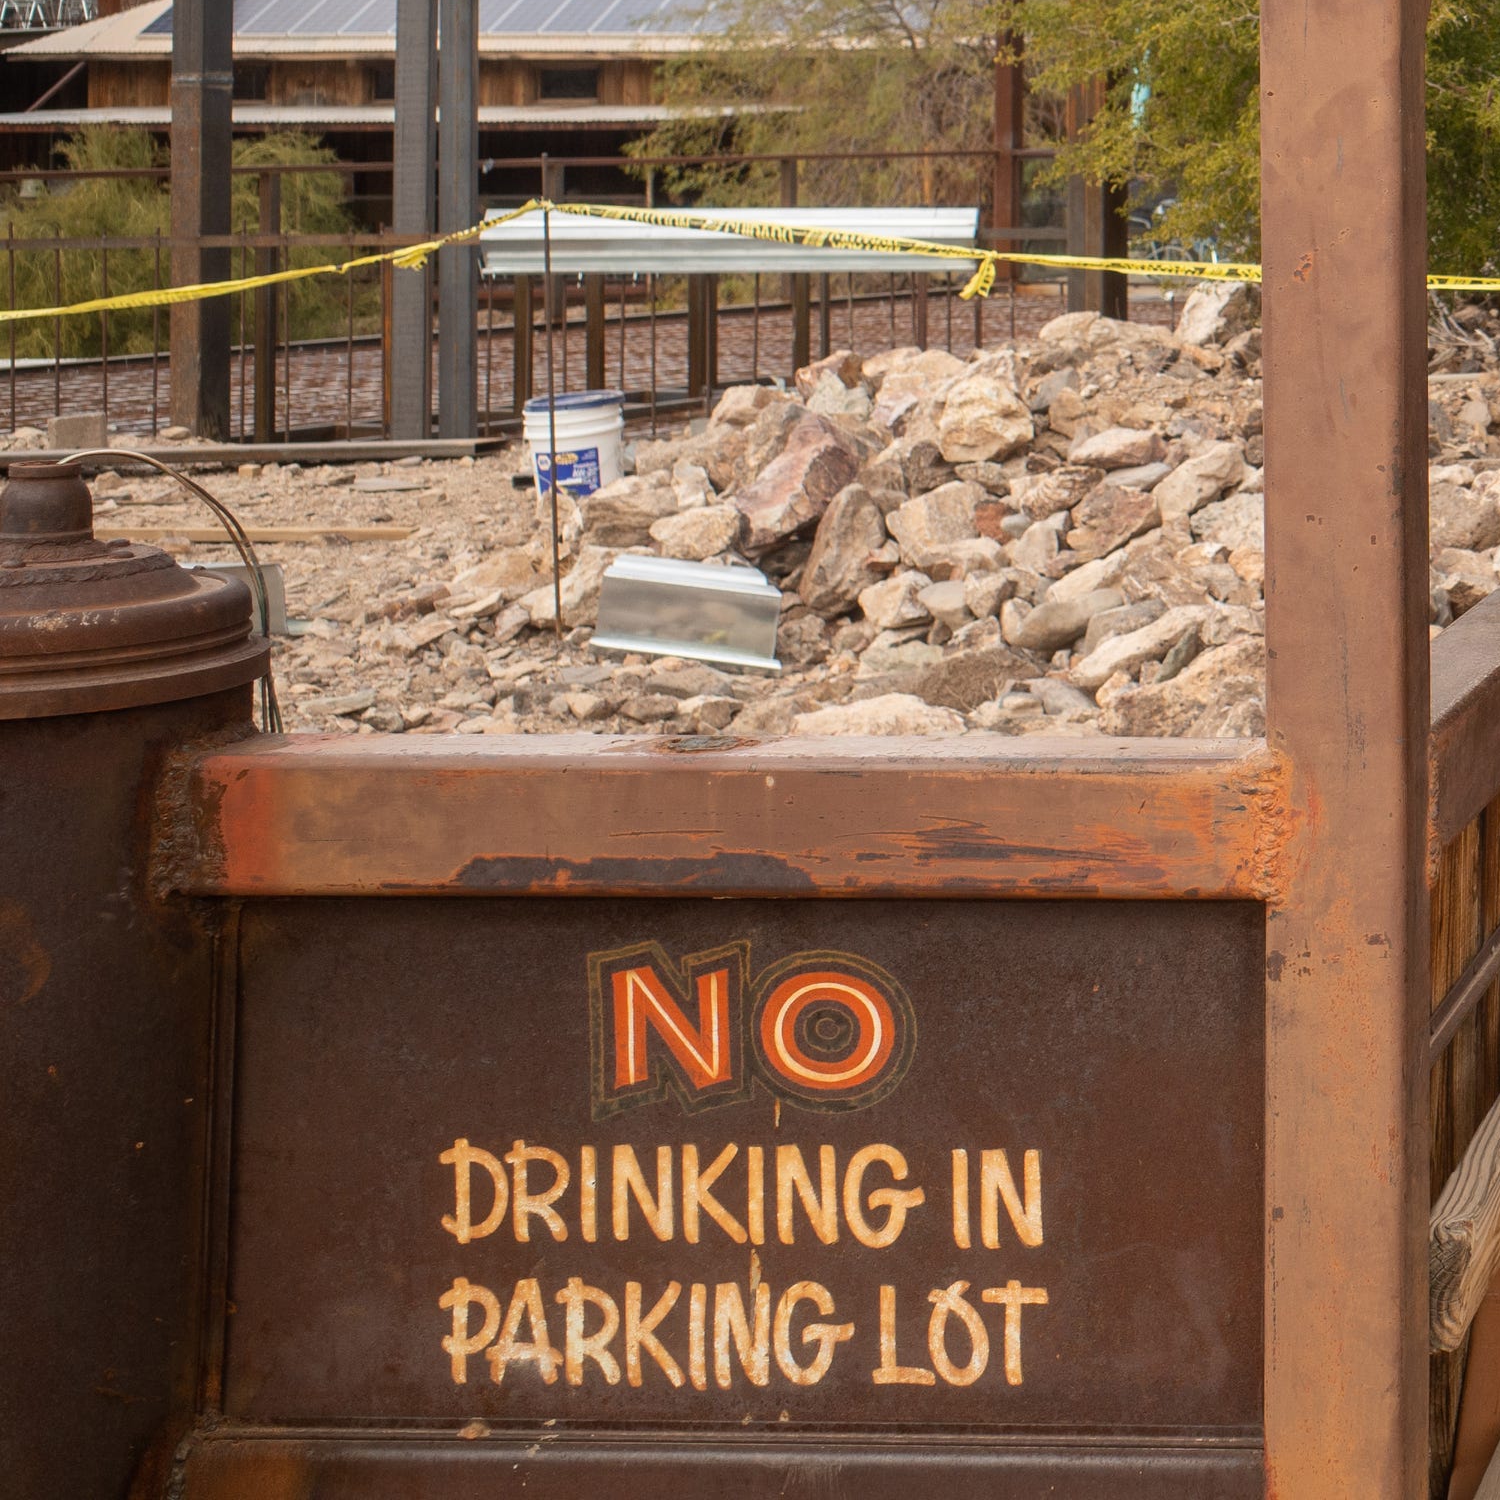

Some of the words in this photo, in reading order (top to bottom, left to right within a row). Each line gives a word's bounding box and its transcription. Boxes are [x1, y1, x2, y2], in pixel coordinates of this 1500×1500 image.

[594, 948, 909, 1110] NO
[439, 1137, 925, 1249] DRINKING
[952, 1148, 1044, 1249] IN
[438, 1276, 855, 1391] PARKING
[872, 1279, 1049, 1387] LOT
